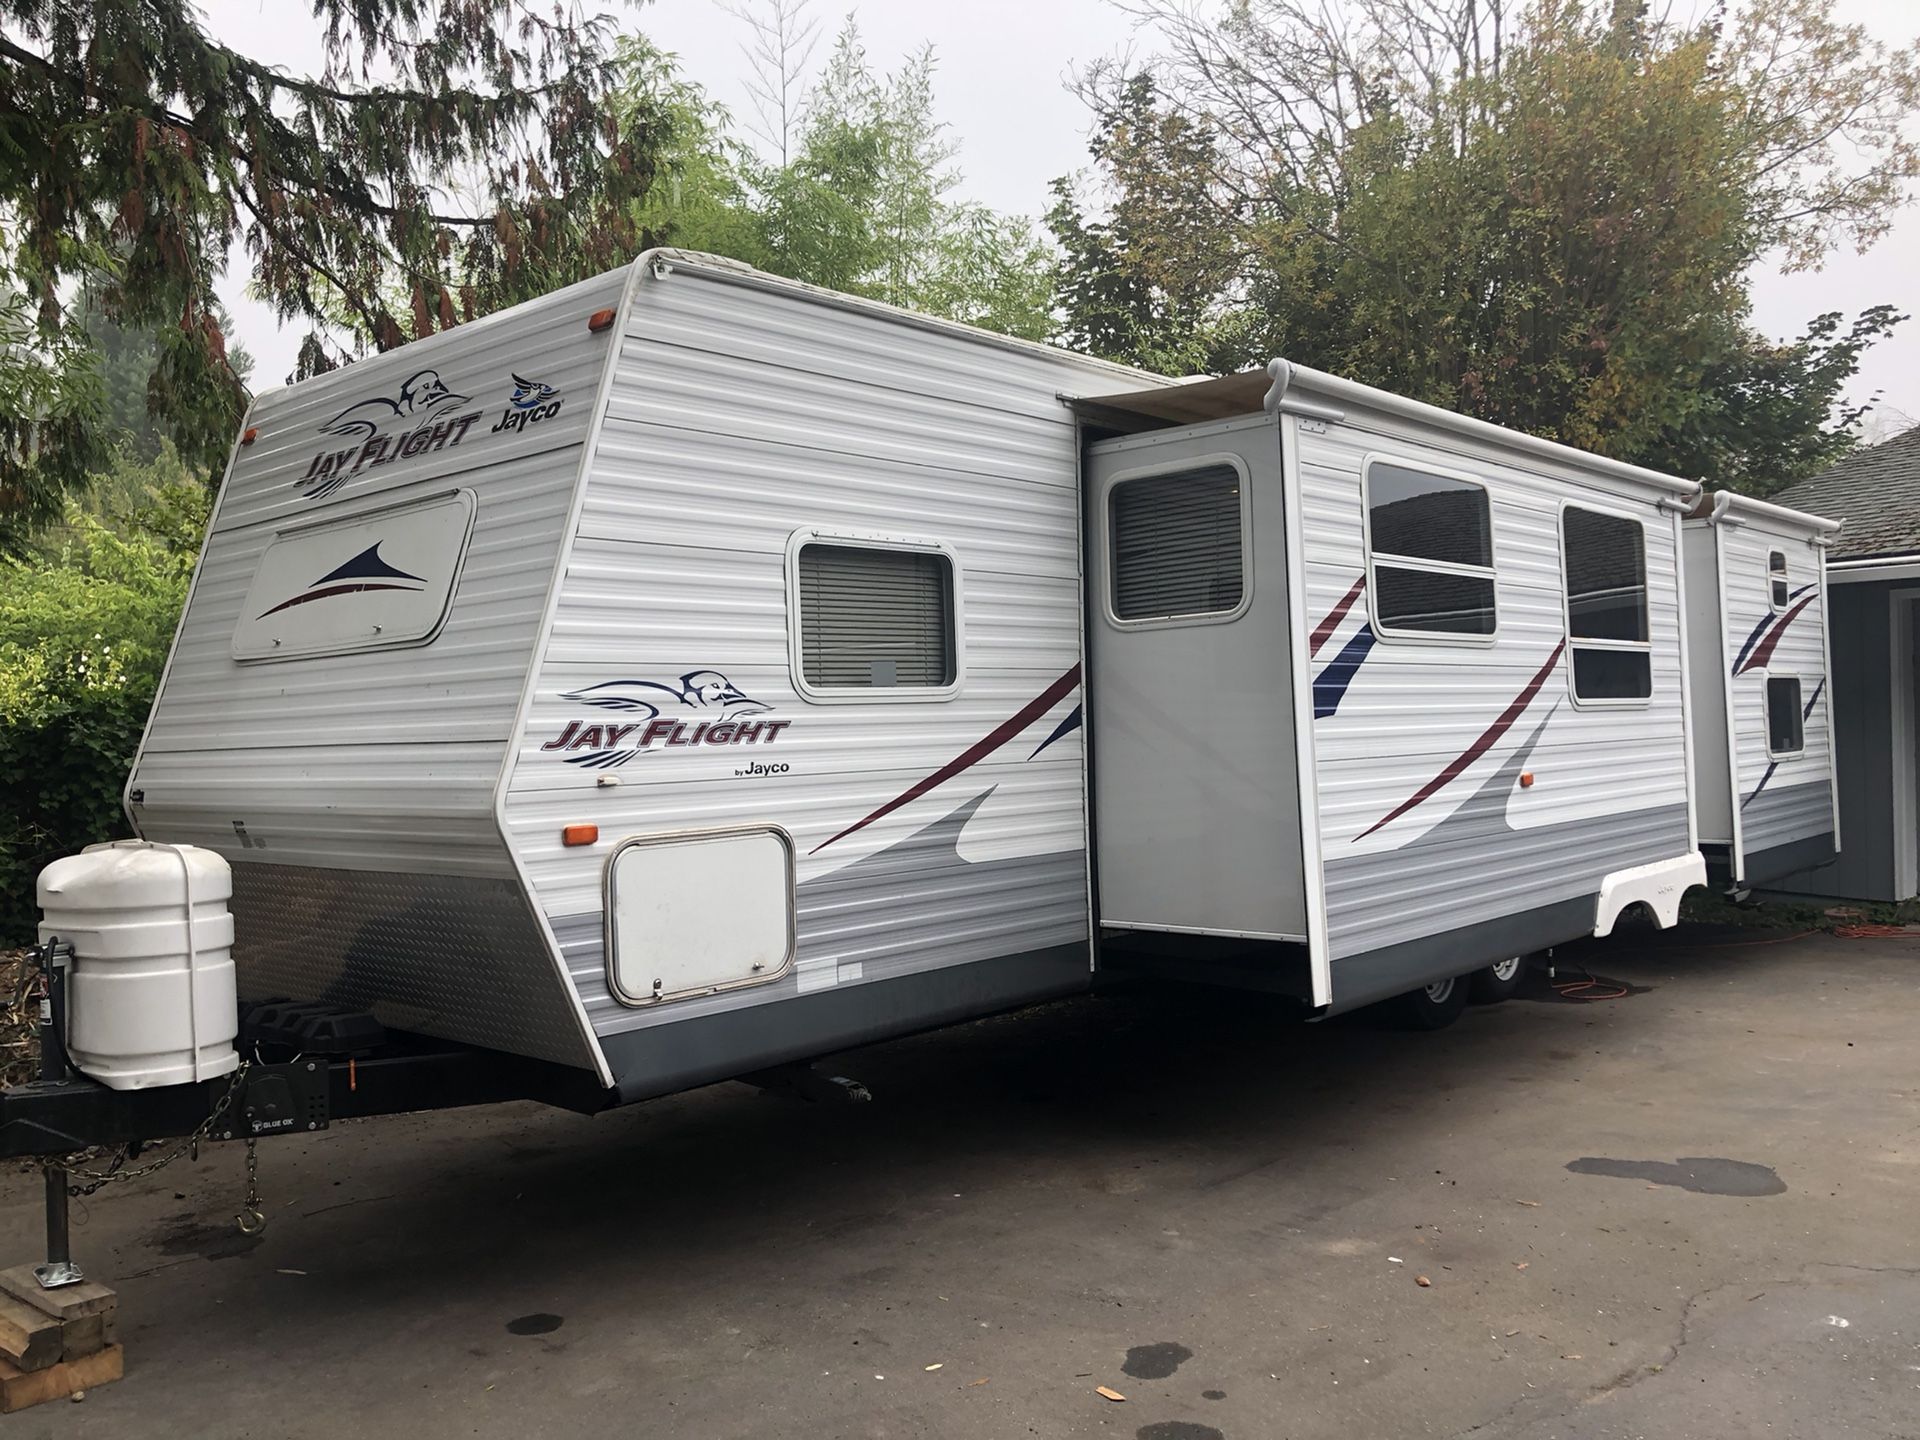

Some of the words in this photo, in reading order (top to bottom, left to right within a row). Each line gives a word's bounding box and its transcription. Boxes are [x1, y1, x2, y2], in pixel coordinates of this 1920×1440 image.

[491, 400, 561, 433] Jayco
[293, 446, 359, 488] JAY
[350, 411, 484, 473] FLIGHT
[540, 720, 641, 751] JAY
[636, 718, 792, 748] FLIGHT
[744, 761, 790, 776] Jayco
[263, 1120, 281, 1129] BLUE
